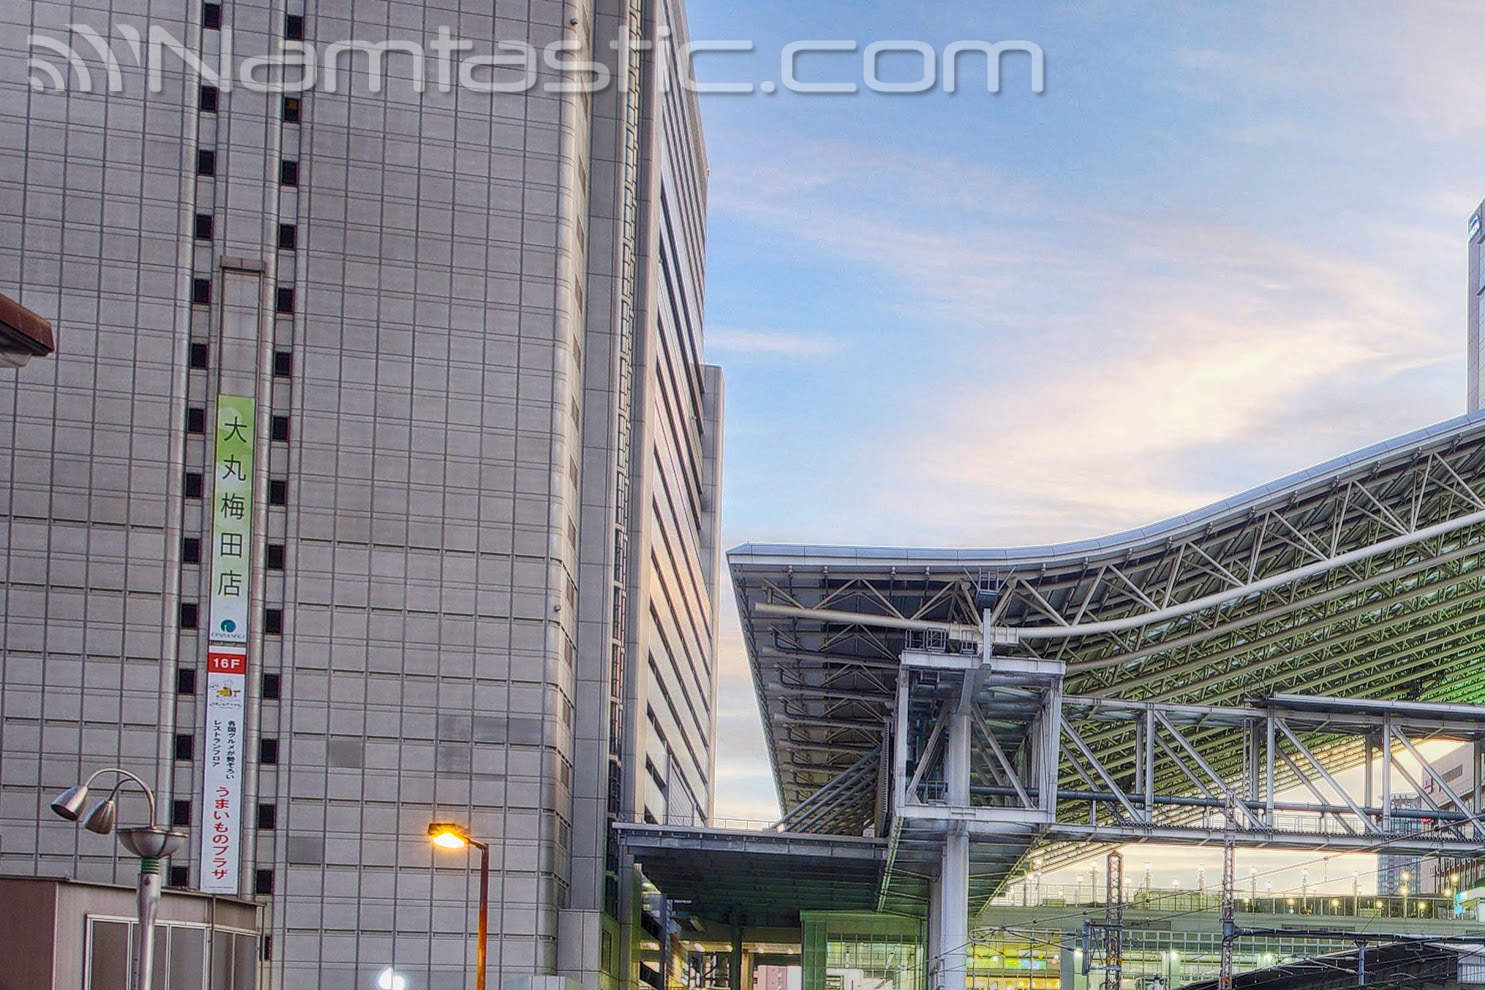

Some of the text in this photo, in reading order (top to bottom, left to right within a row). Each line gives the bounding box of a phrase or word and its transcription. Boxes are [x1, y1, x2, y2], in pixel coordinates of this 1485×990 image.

[217, 416, 248, 597] 大丸梅田店
[212, 657, 241, 669] 16F
[210, 786, 231, 881] うまいものプラザ
